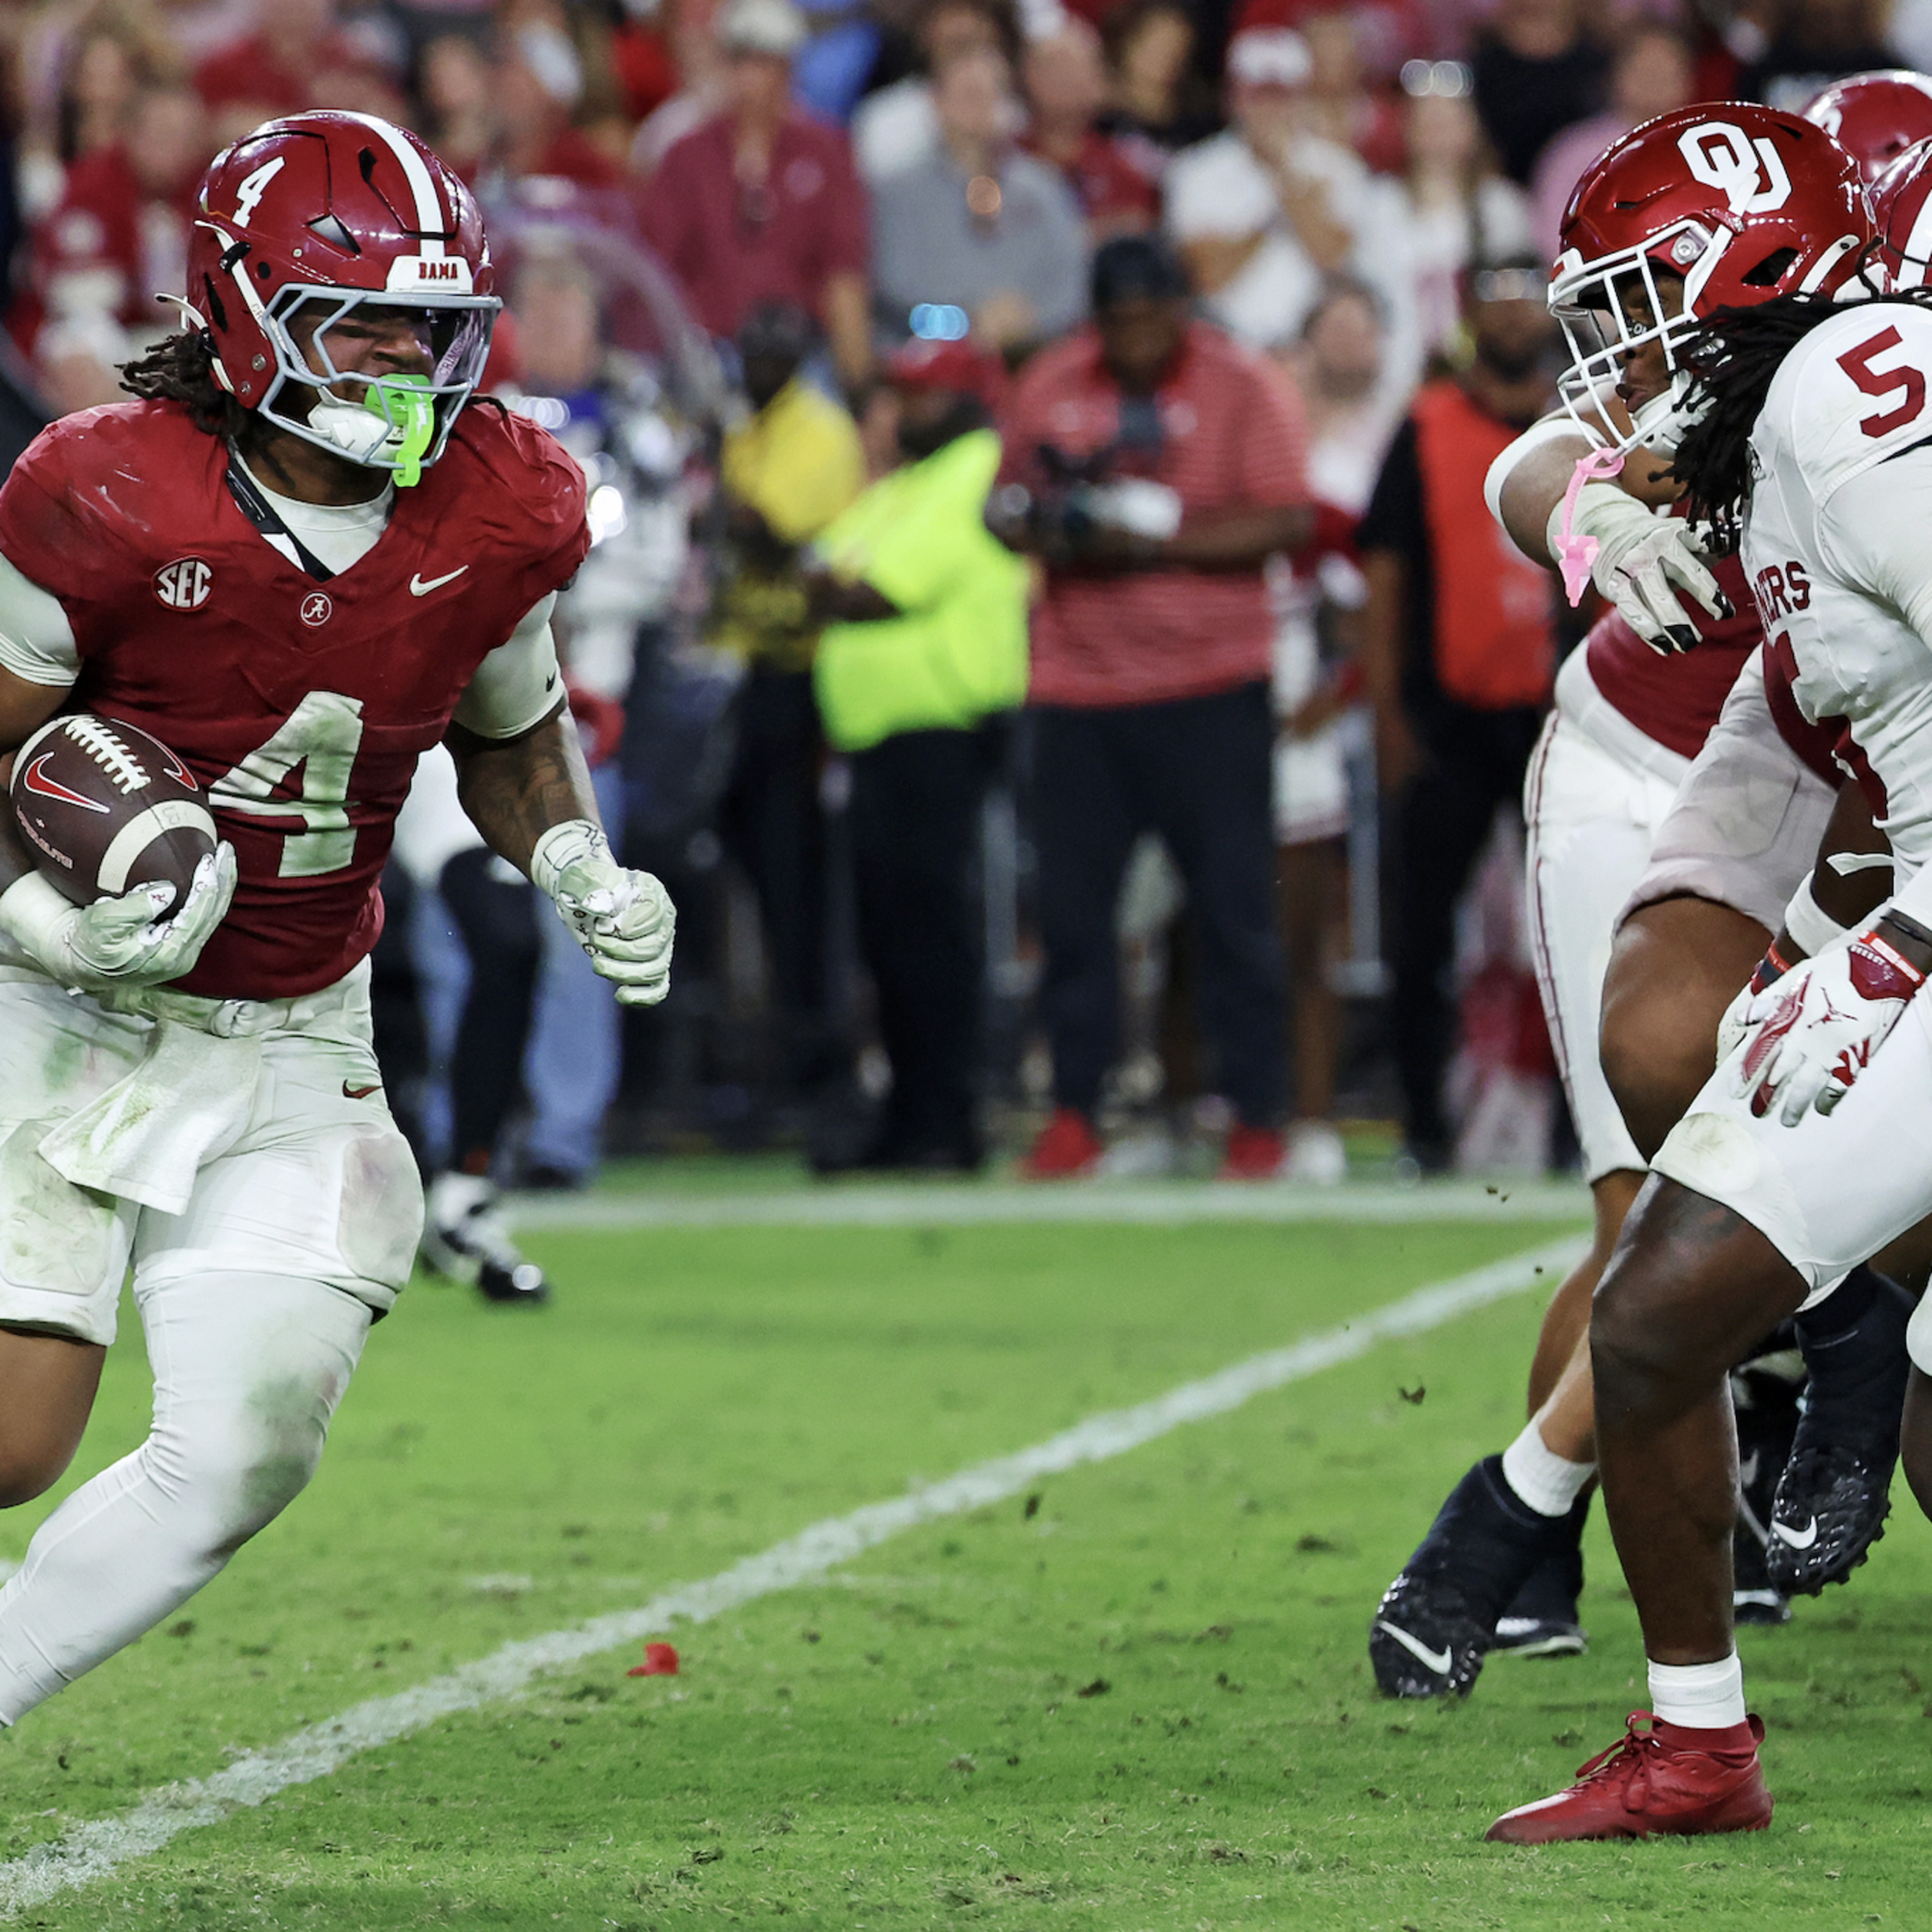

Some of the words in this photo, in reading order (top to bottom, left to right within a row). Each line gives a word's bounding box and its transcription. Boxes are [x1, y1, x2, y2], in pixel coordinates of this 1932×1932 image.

[232, 156, 285, 228] 4
[1676, 121, 1792, 215] OU
[419, 262, 457, 280] BAMA
[1836, 325, 1925, 439] 5
[157, 561, 212, 608] SEC
[209, 691, 365, 877] 4
